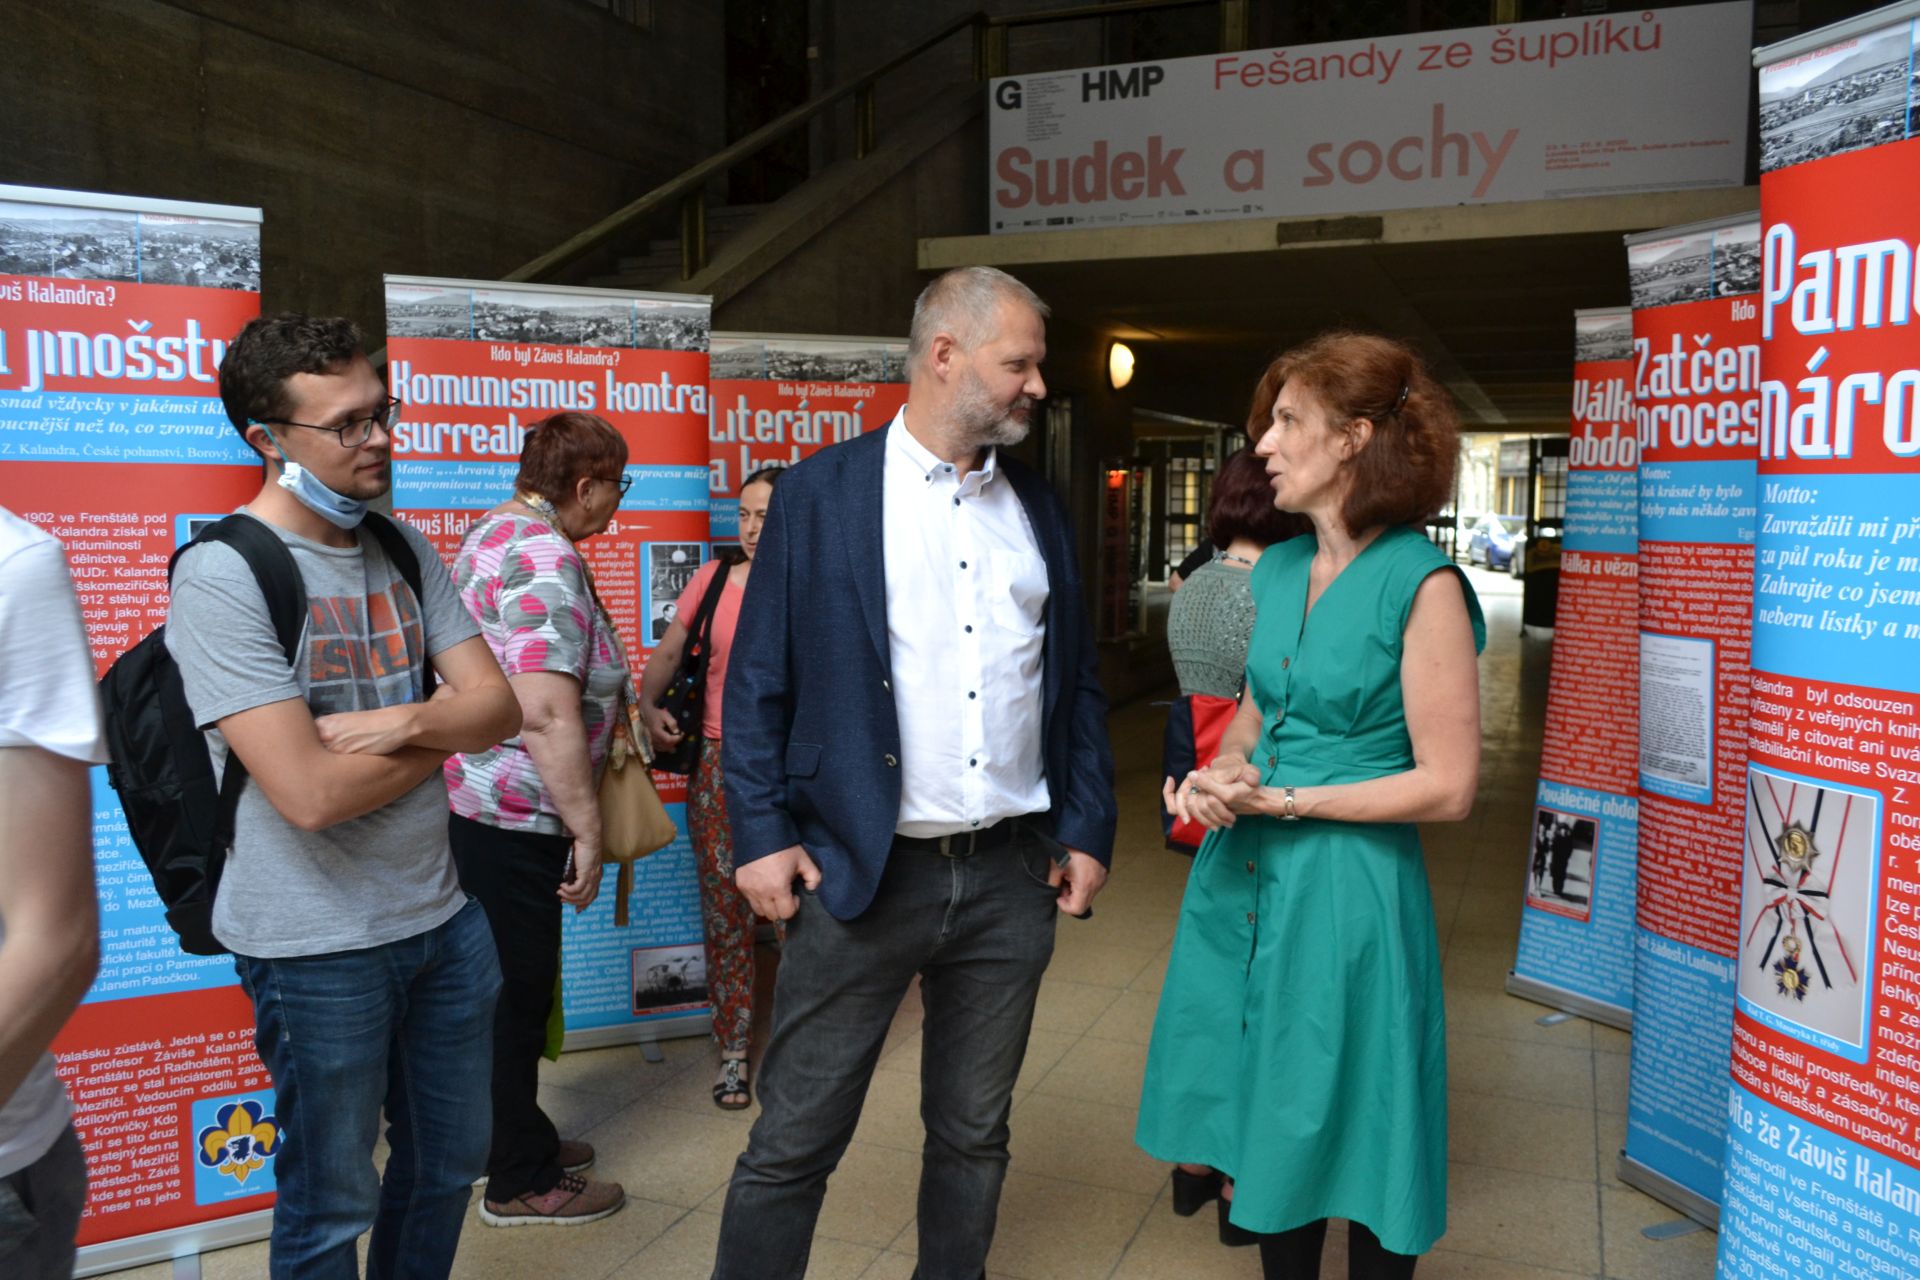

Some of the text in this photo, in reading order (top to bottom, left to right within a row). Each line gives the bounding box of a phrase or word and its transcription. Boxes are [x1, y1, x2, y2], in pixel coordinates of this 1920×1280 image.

[1214, 11, 1661, 91] Fešandy ze šuplíků
[996, 80, 1022, 110] G
[1082, 66, 1164, 102] HMP
[996, 135, 1186, 208] Sudek
[1223, 148, 1264, 192] a
[1302, 103, 1519, 198] sochy
[1762, 223, 1920, 340] Pam
[28, 281, 116, 307] Kalandra?
[1732, 301, 1755, 321] Kdo
[491, 345, 620, 366] Kdo byl Záviš Kalandra?
[1634, 333, 1760, 399] Zatčen
[391, 360, 708, 414] Komunismus kontra
[779, 384, 875, 399] Kdo byl Záviš Kalandra?
[49, 397, 114, 414] vždycky
[131, 400, 197, 415] jakémsi
[75, 421, 214, 435] než zrovna
[709, 395, 864, 443] Literární
[1637, 400, 1759, 465] proces
[20, 444, 79, 456] Kalandra,
[84, 443, 120, 456] České
[188, 447, 232, 459] Borový,
[395, 464, 433, 476] Motto:
[709, 459, 728, 492] a
[395, 479, 514, 491] kompromitovat socia
[1658, 486, 1696, 497] krásné
[1698, 485, 1712, 500] by
[1716, 484, 1742, 500] bylo
[1763, 483, 1818, 504] Motto:
[81, 512, 138, 522] Frenštátě
[144, 514, 166, 525] pod
[1669, 507, 1688, 516] nás
[1692, 505, 1729, 516] někdo
[52, 527, 148, 536] Kalandra získal
[1762, 513, 1888, 538] Zavraždili mi
[71, 554, 168, 563] dělnictva. Jako
[1561, 552, 1590, 574] Válka
[1762, 545, 1891, 576] za půl roku je
[70, 568, 168, 577] MUDr. Kalandra
[109, 594, 149, 605] stěhují
[1760, 574, 1920, 608] Zahrajte co jsem
[115, 609, 140, 619] jako
[1759, 606, 1898, 640] neberu lístky a
[1751, 675, 1913, 715] Kalandra byl odsouzen
[1809, 710, 1882, 733] veřejných
[1787, 725, 1884, 755] je citovat ani
[1815, 750, 1870, 774] komise
[1892, 787, 1909, 804] Z.
[1886, 895, 1910, 915] lze
[108, 936, 156, 950] maturitě
[136, 948, 176, 961] fakultě
[167, 954, 237, 970] Parmenidov
[100, 973, 200, 991] Janem Patočkou.
[55, 1034, 205, 1063] Valašsku zůstává. Jedná
[91, 1057, 144, 1073] profesor
[155, 1048, 195, 1062] Záviše
[77, 1071, 133, 1086] Frenštátu
[138, 1067, 160, 1080] pod
[80, 1067, 232, 1100] kantor stal iniciátorem
[1769, 1043, 1890, 1106] násilí prostředky,
[135, 1088, 194, 1103] Vedoucím
[201, 1080, 237, 1093] oddílu
[1771, 1065, 1810, 1094] lidský
[1832, 1092, 1907, 1135] zásadový
[132, 1103, 177, 1116] rádcem
[1772, 1083, 1849, 1130] Valašskem
[94, 1115, 178, 1137] Konvičky. Kdo
[127, 1128, 178, 1144] tito druzi
[101, 1143, 161, 1161] stejný den
[1758, 1111, 1846, 1181] že Záviš
[132, 1152, 179, 1169] Meziříčí
[90, 1166, 180, 1189] městech. Záviš
[1745, 1149, 1884, 1227] narodil ve Frenštátě
[92, 1181, 164, 1203] kde dnes
[101, 1191, 181, 1213] nese jeho
[1730, 1177, 1851, 1252] zakládal skautskou
[1783, 1188, 1838, 1226] Vsetině
[1735, 1218, 1825, 1276] Moskvě ve 30.
[1752, 1212, 1834, 1265] první odhalil
